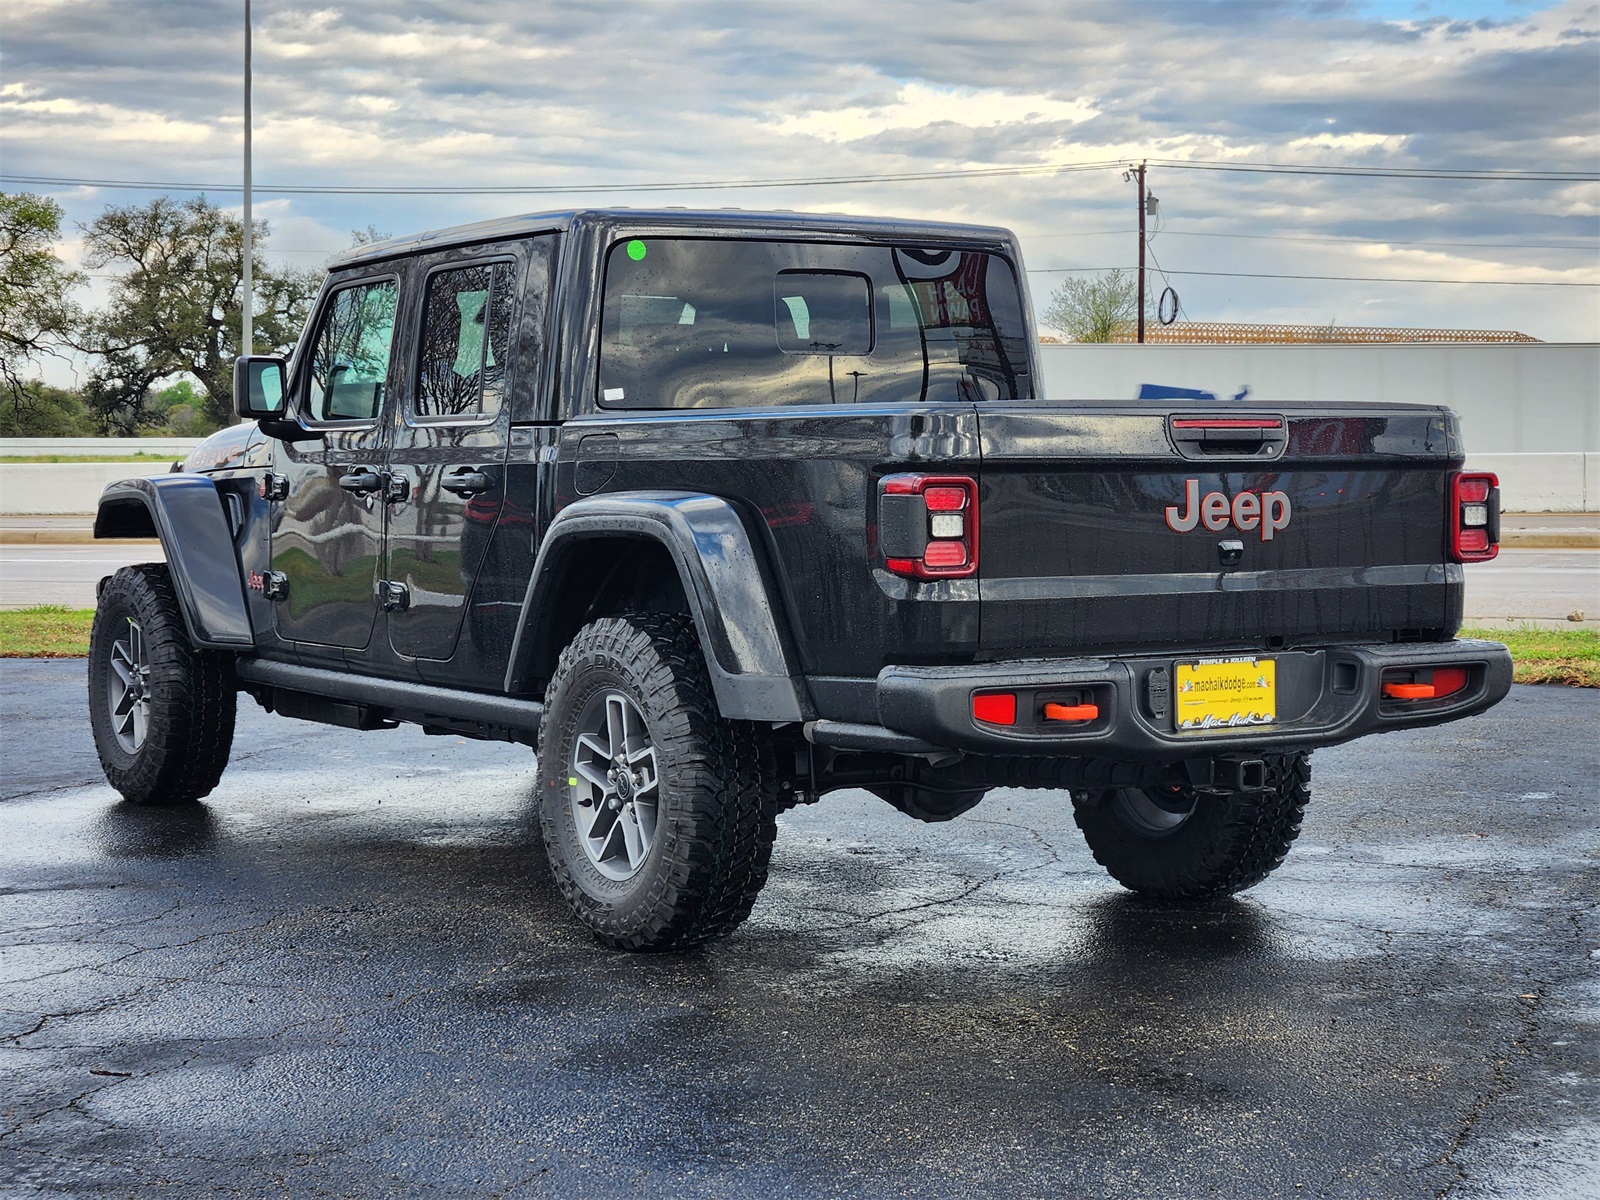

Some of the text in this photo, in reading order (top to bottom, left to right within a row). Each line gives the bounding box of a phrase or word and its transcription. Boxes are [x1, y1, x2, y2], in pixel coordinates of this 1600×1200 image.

[1165, 479, 1292, 541] Jeep
[1194, 675, 1256, 692] machaikdodge.com
[1202, 714, 1224, 729] Mac
